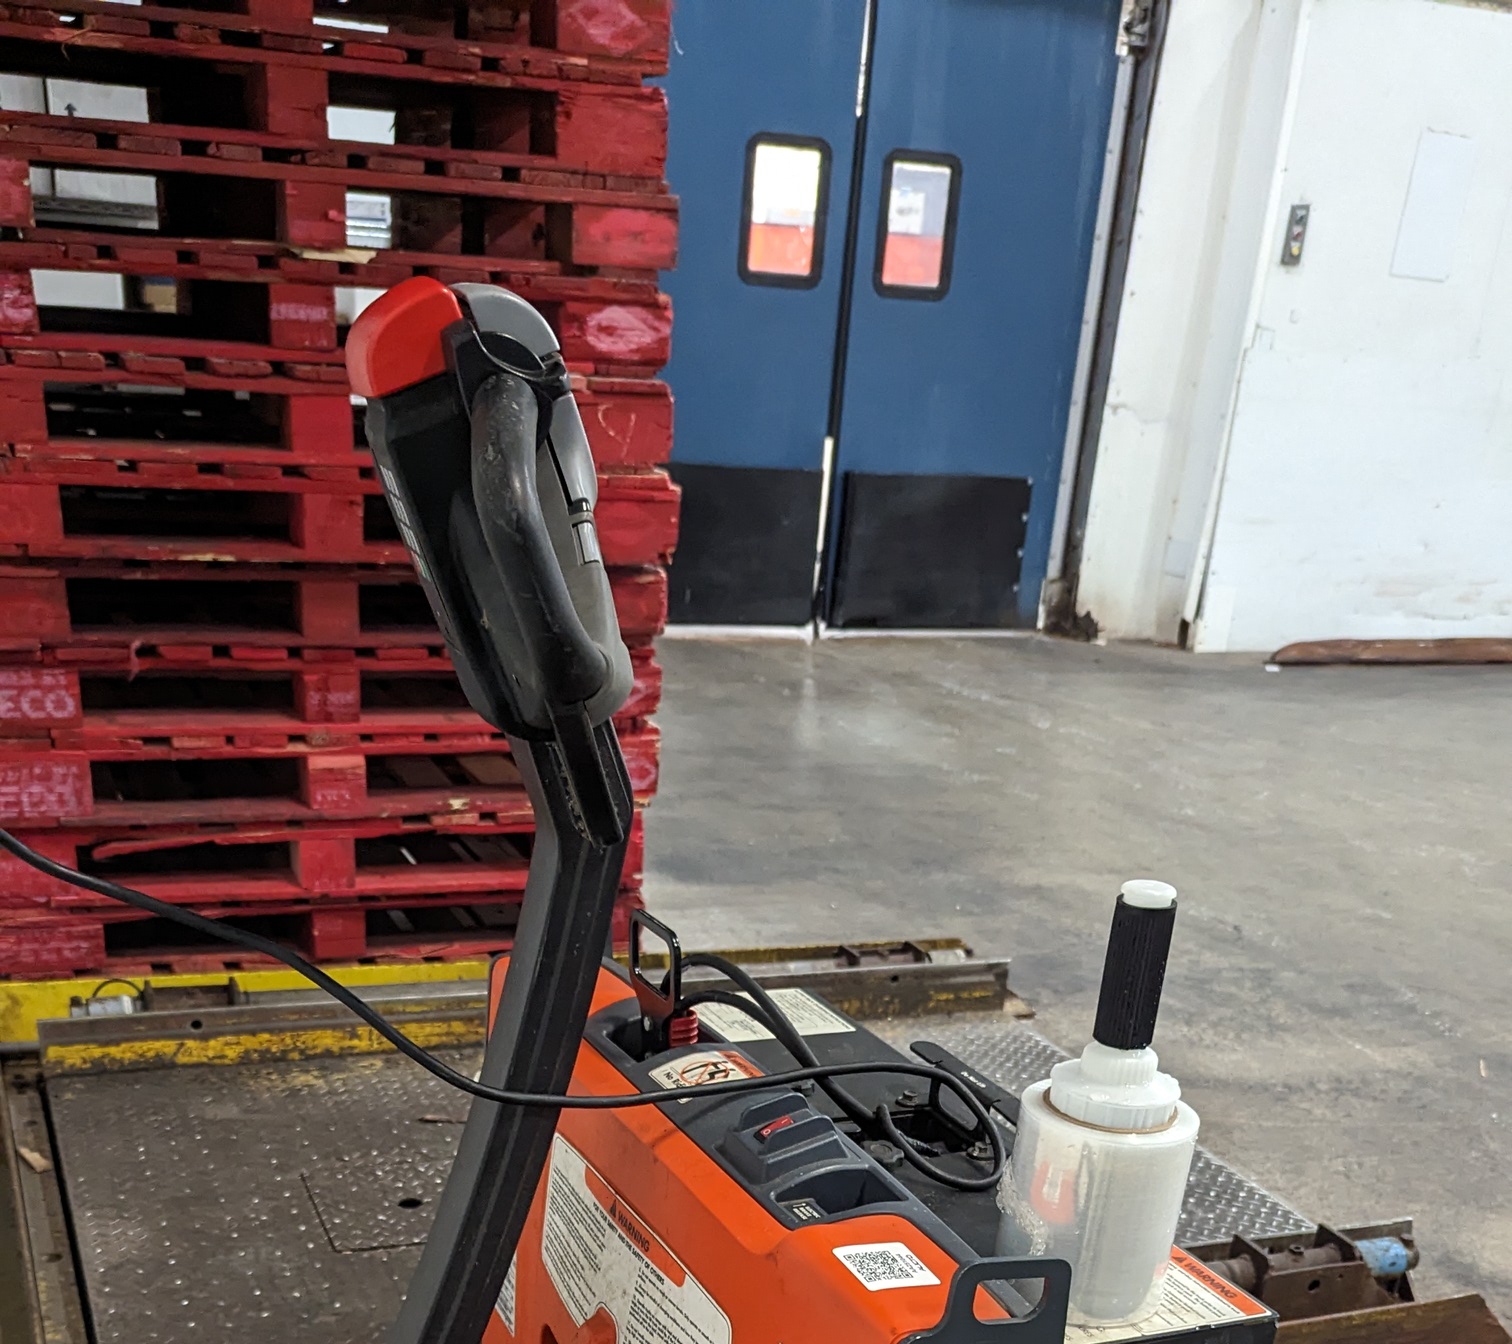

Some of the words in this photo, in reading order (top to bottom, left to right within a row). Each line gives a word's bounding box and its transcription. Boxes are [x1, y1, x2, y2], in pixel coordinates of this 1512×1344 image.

[618, 1210, 650, 1252] WARNING
[632, 1248, 645, 1264] SAFETY
[644, 1261, 650, 1269] OF
[1184, 1263, 1237, 1298] WARNING
